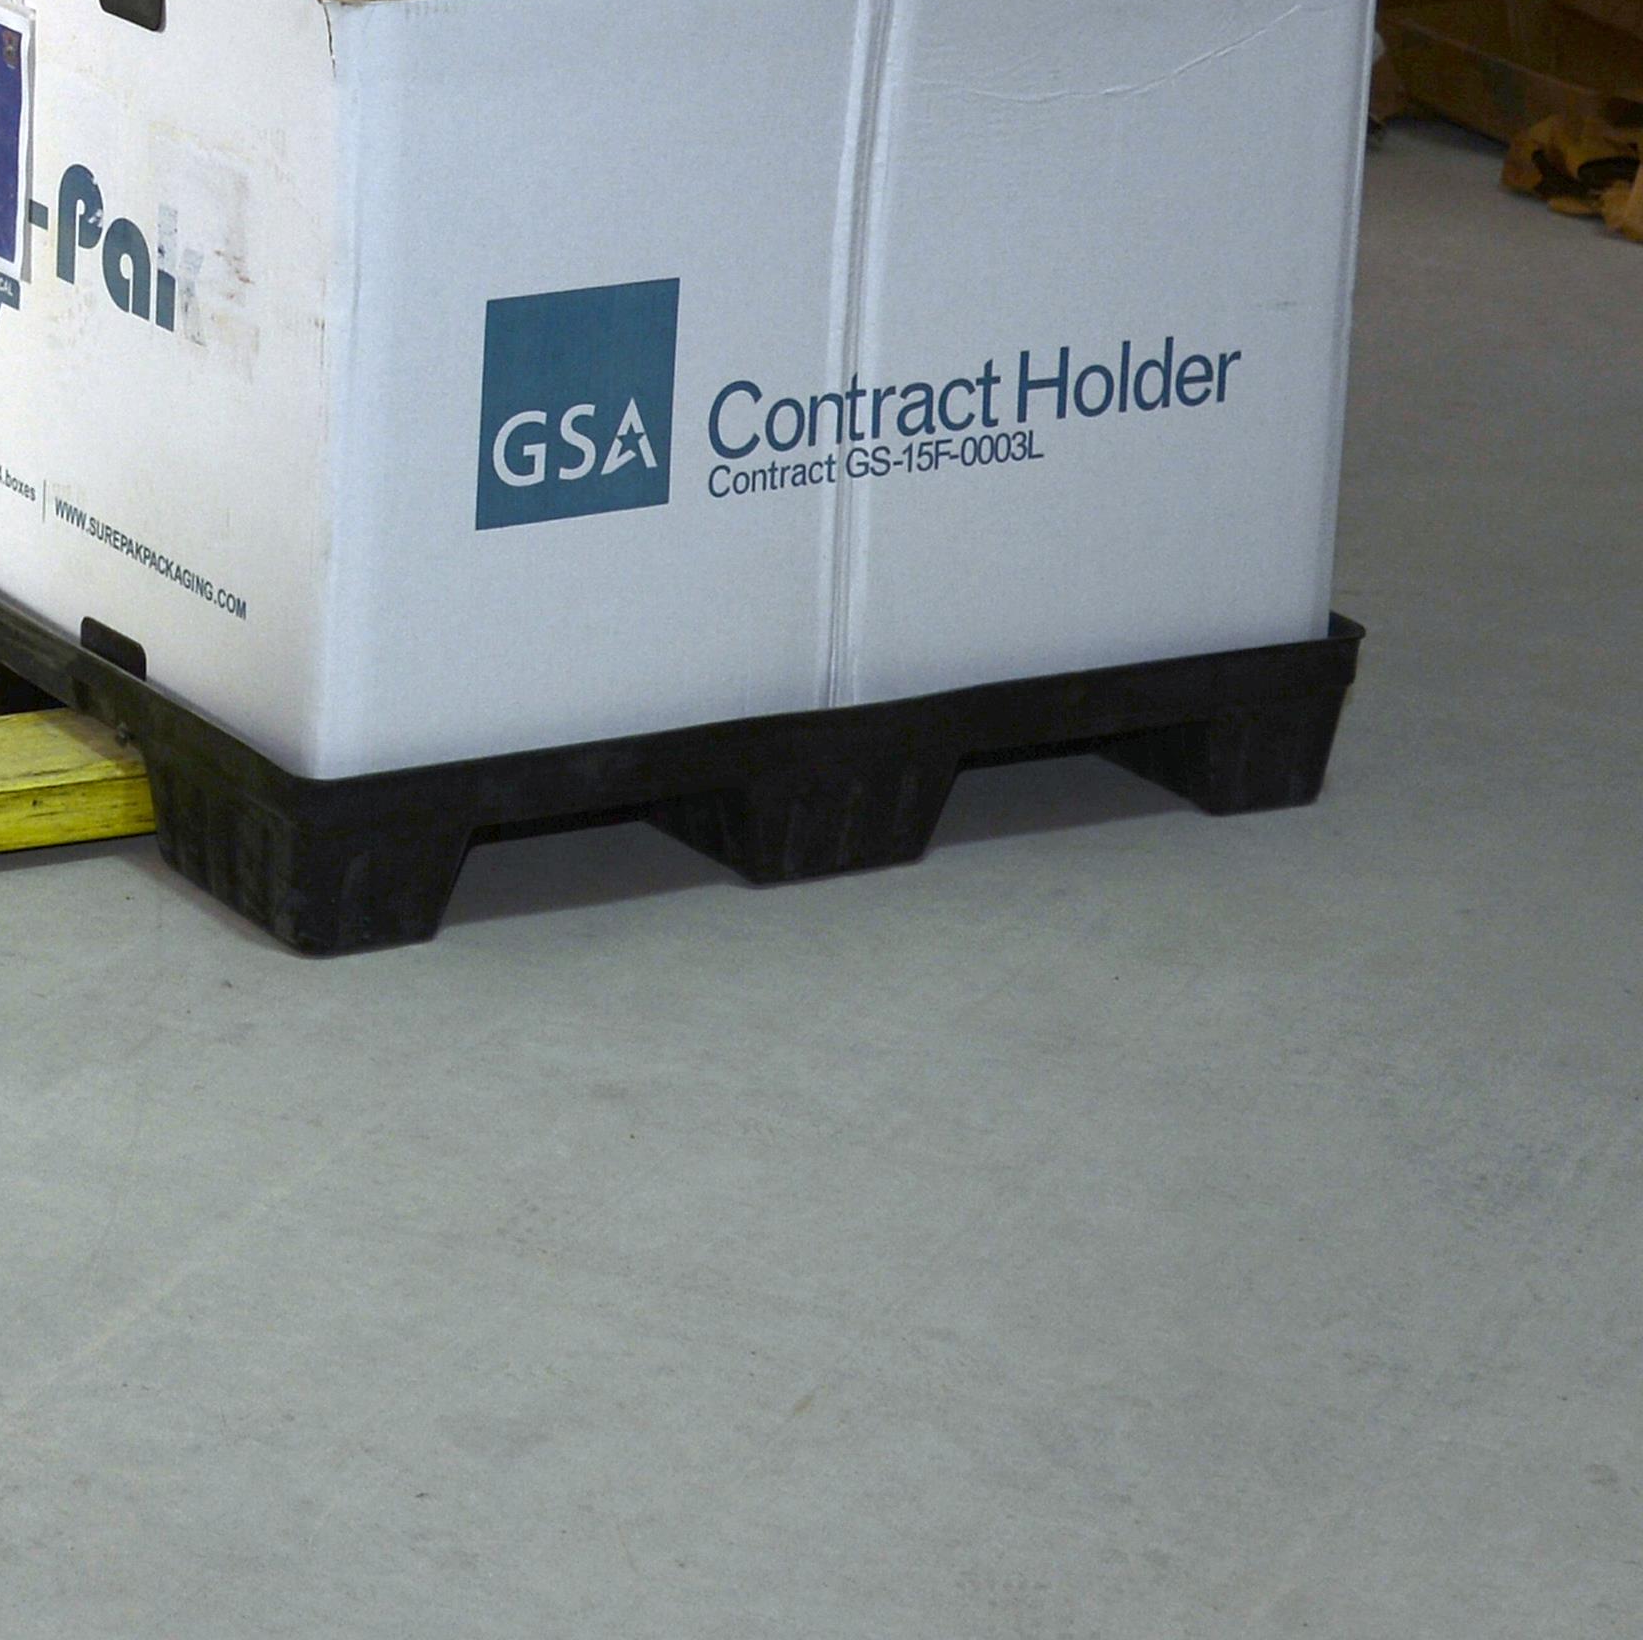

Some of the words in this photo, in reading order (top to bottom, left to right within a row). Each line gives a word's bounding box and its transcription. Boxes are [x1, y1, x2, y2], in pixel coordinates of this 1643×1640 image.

[491, 397, 659, 488] GSA
[708, 358, 999, 461] Contract
[1016, 335, 1242, 424] Holder
[708, 453, 837, 499] Contract
[845, 429, 1044, 480] GS-15F-0003L
[54, 496, 248, 621] WWW.SUREPAKPACKAGING.COM
